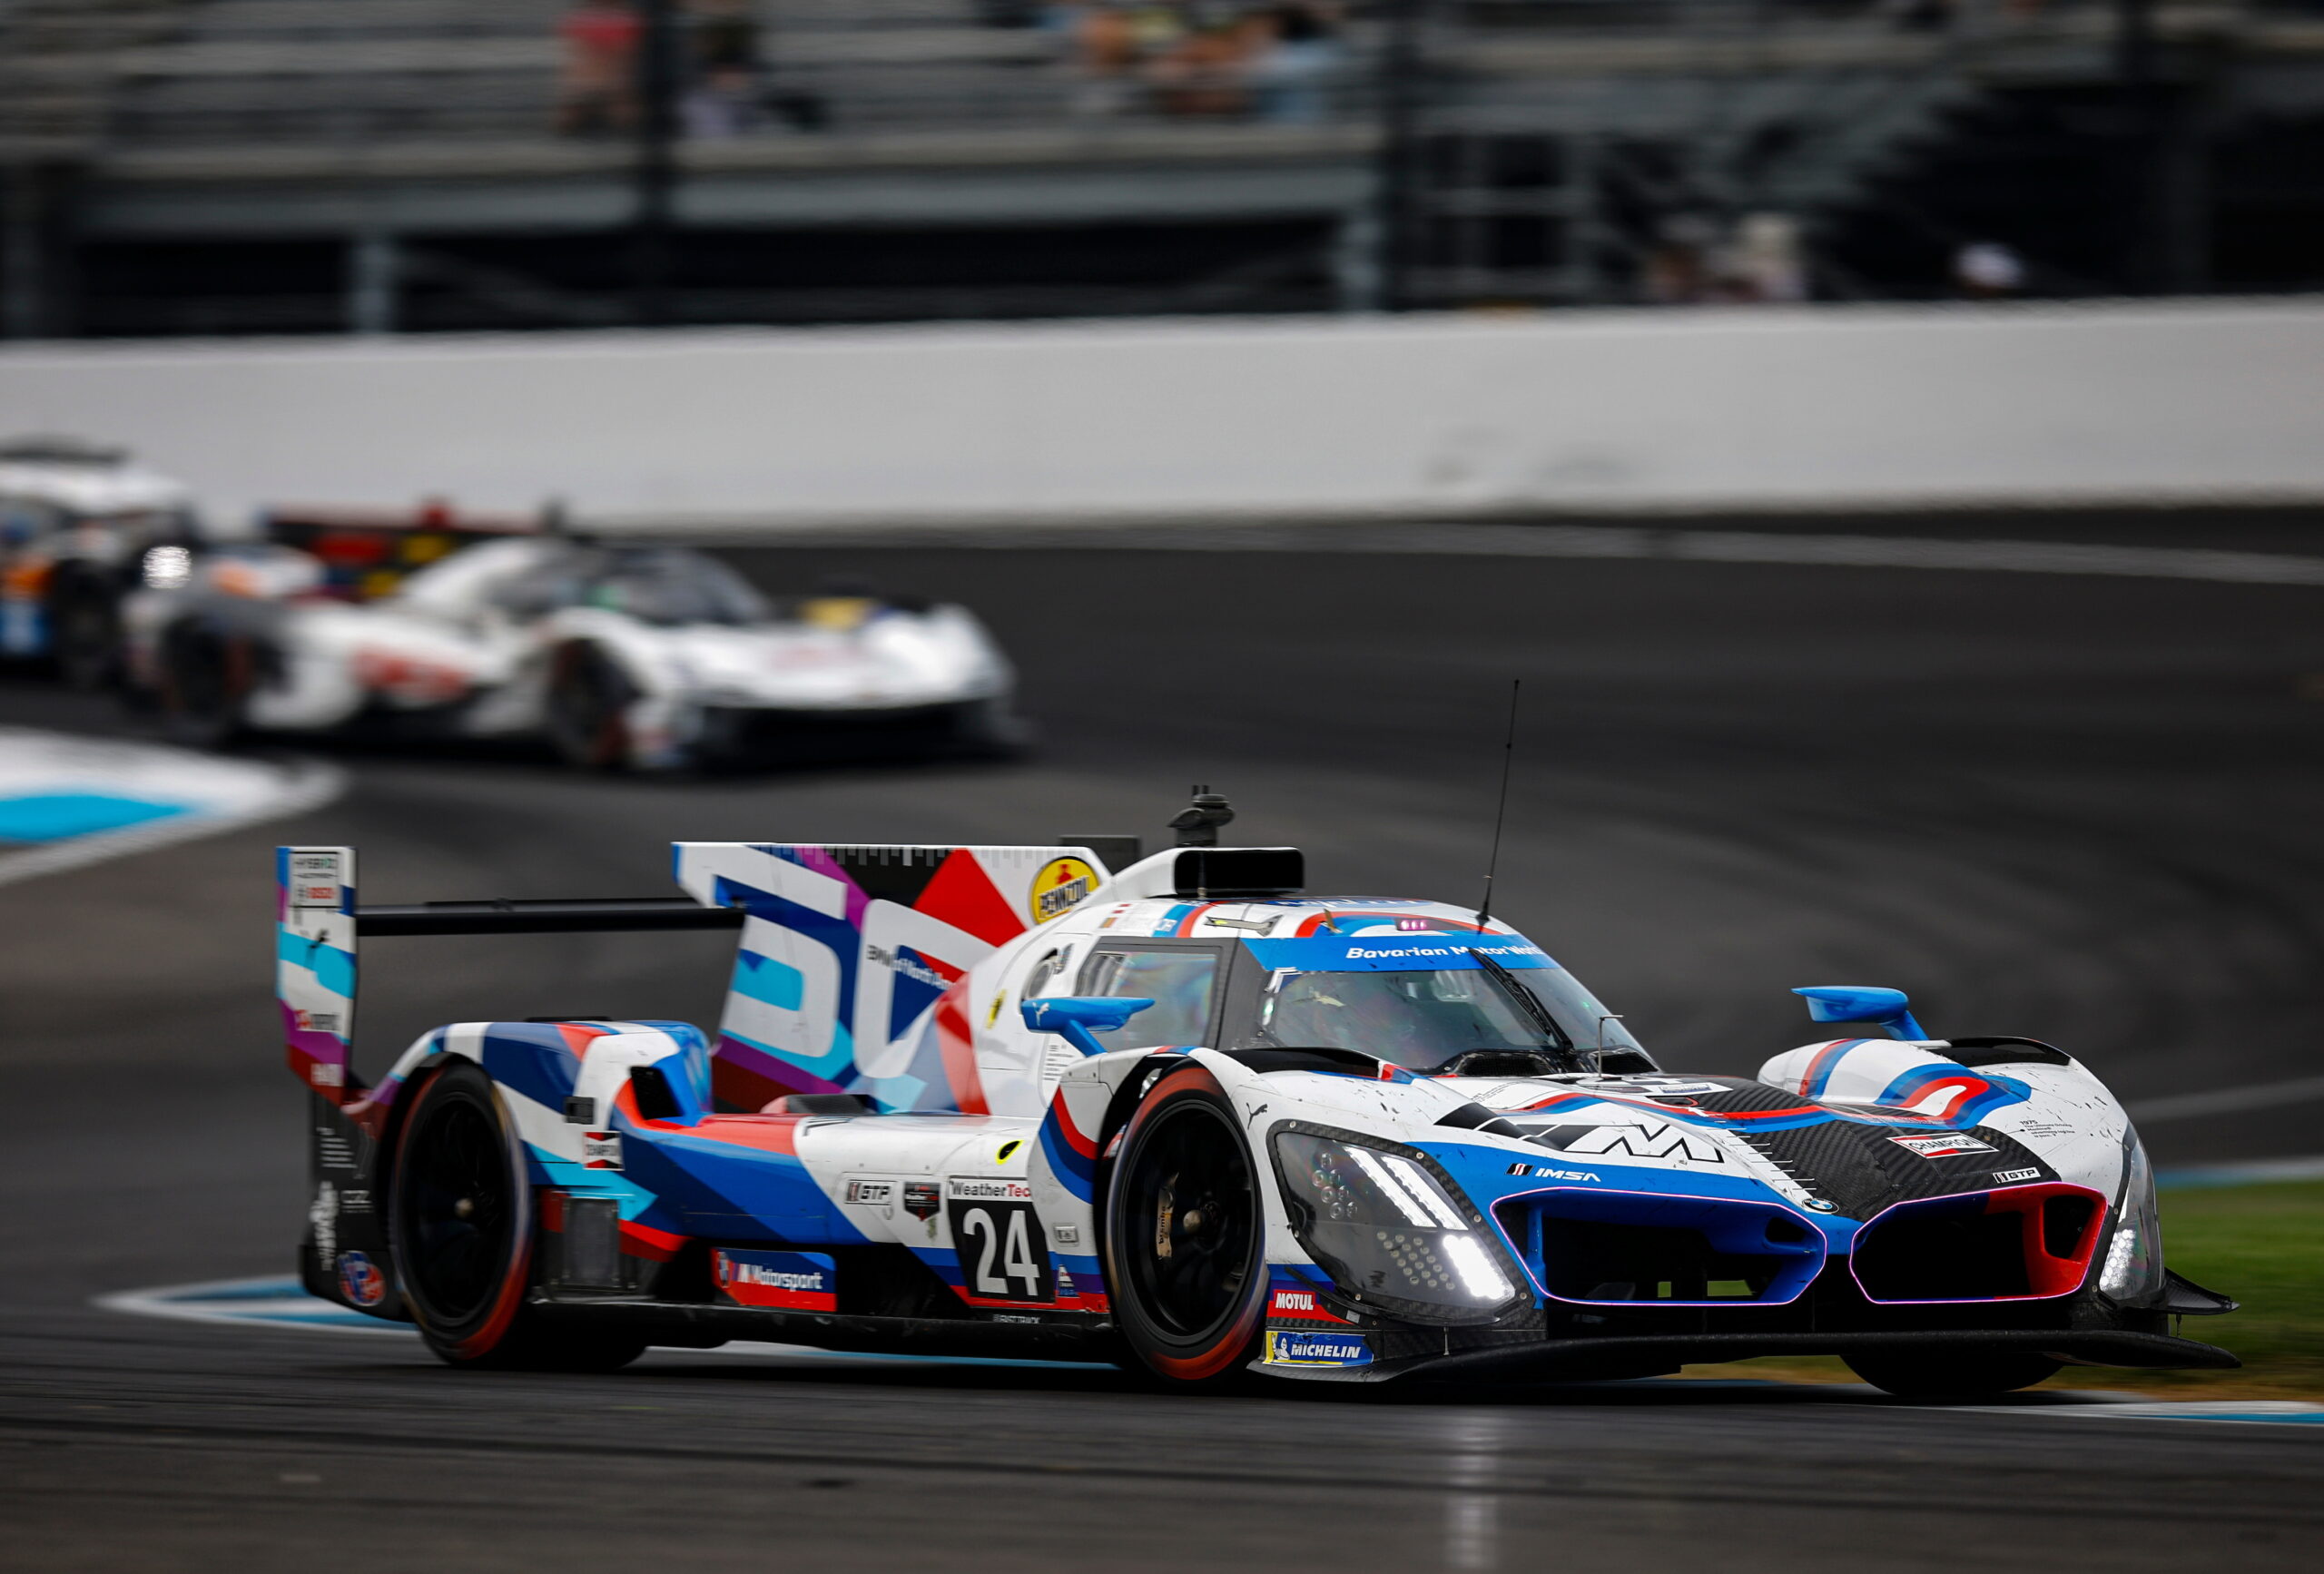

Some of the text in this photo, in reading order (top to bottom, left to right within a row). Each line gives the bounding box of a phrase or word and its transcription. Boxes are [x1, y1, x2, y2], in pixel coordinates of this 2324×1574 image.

[1039, 877, 1089, 920] PENNZOIL
[1345, 946, 1449, 959] Bavarian
[1908, 1136, 1984, 1151] CHAMPION
[1535, 1167, 1601, 1182] IMSA
[2007, 1168, 2037, 1179] GTP
[861, 1185, 891, 1200] GTP
[962, 1207, 1040, 1296] 24
[1275, 1293, 1314, 1311] MOTUL
[1291, 1343, 1361, 1359] MICHELIN
